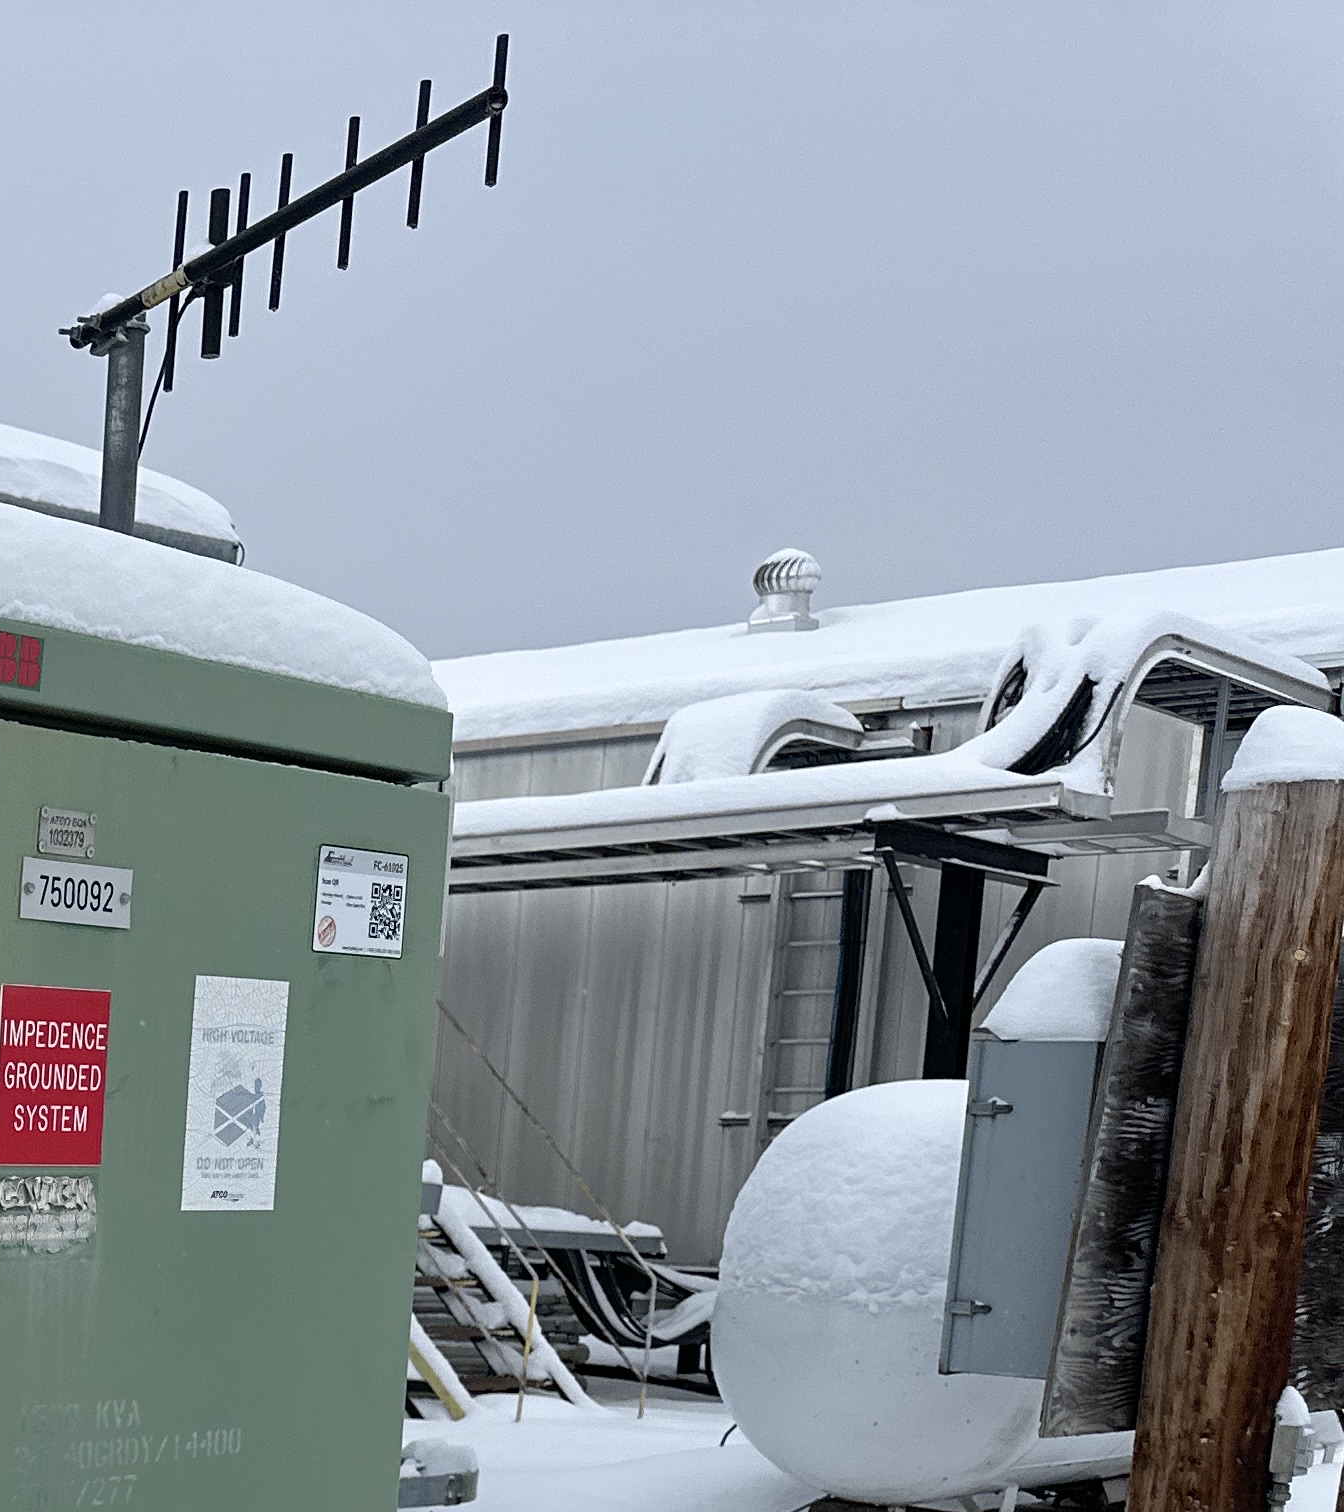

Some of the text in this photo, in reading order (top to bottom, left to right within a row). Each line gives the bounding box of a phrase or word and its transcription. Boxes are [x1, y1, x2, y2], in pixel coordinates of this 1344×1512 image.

[39, 874, 114, 913] 750092
[3, 1019, 108, 1050] IMPEDENCE
[202, 1028, 275, 1045] HIGH VOLTAGE
[4, 1062, 102, 1091] GROUNDED
[13, 1104, 88, 1132] SYSTEM
[196, 1157, 211, 1170] DO
[237, 1157, 264, 1170] OPEN
[211, 1190, 229, 1199] ATCO
[94, 1398, 142, 1430] KVA
